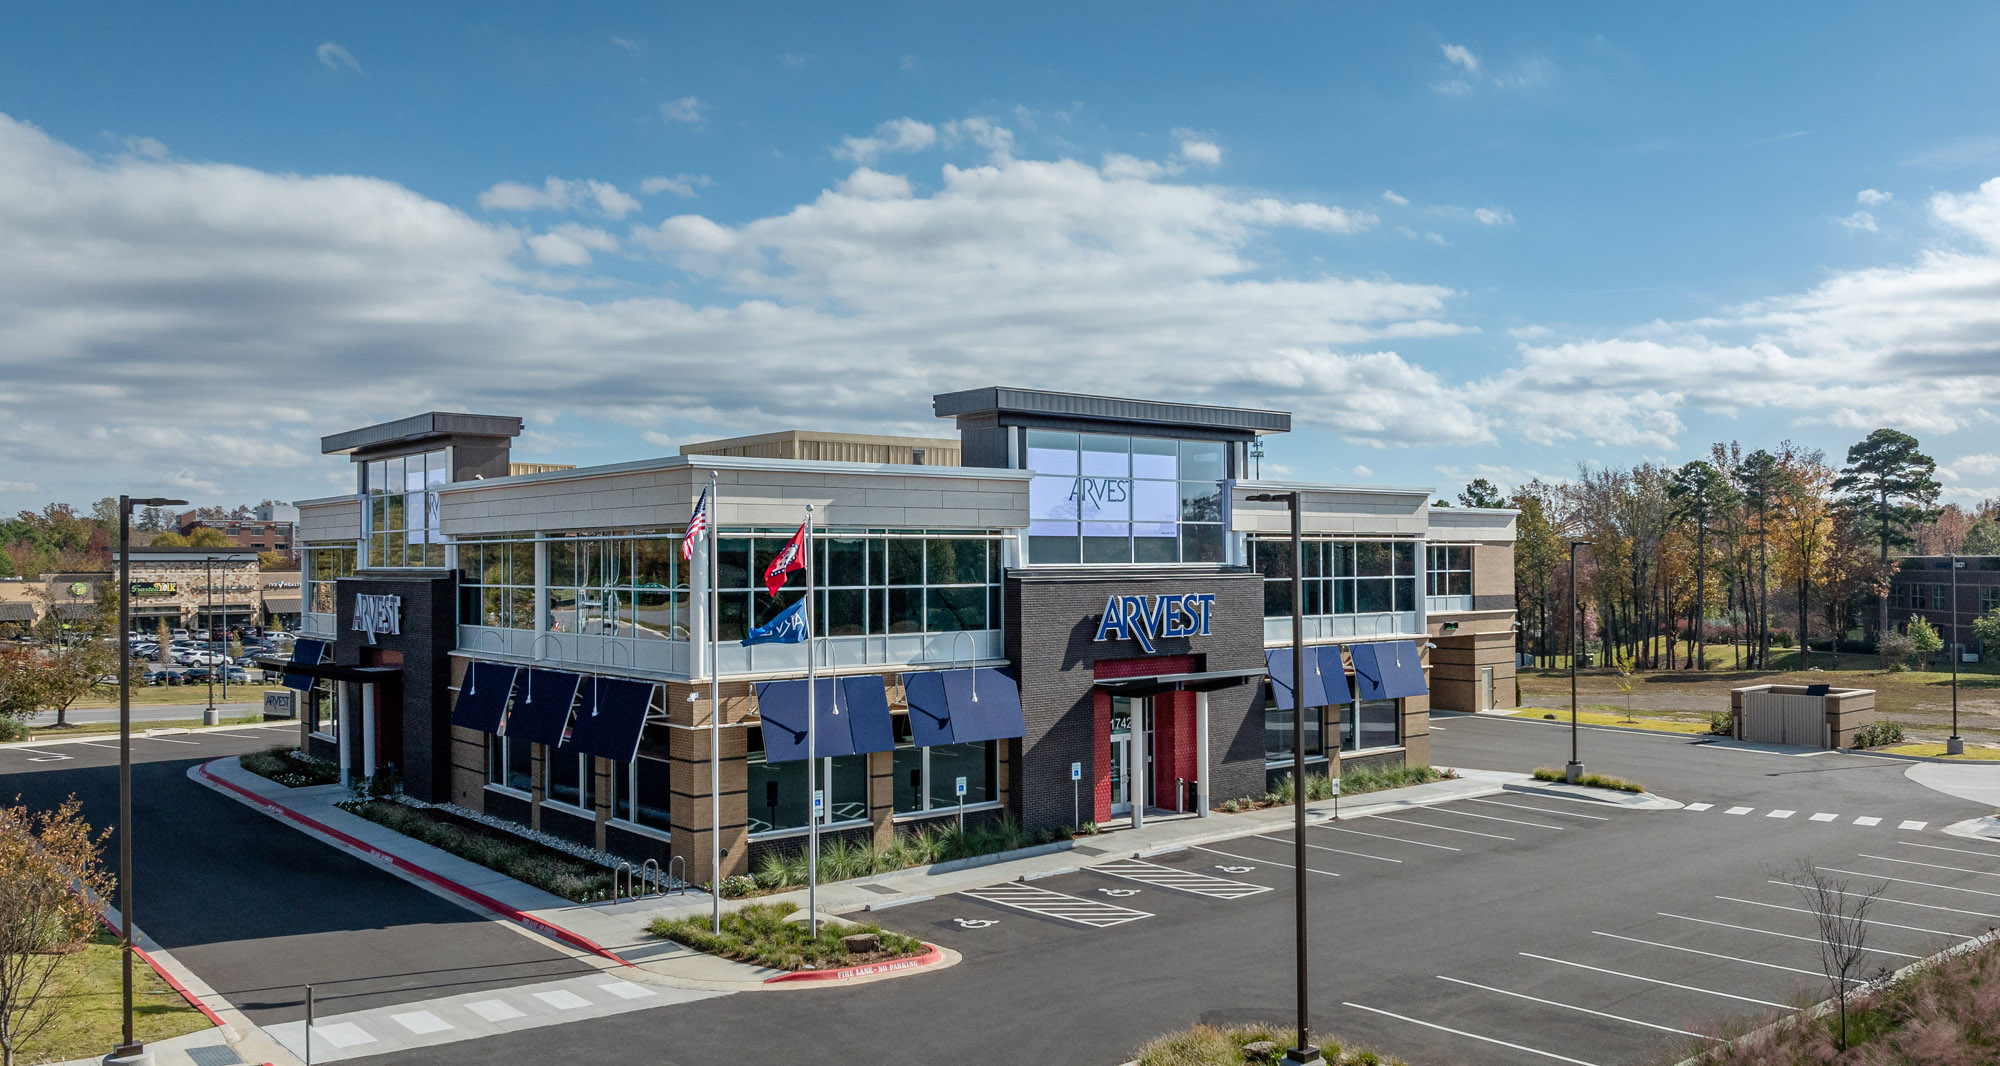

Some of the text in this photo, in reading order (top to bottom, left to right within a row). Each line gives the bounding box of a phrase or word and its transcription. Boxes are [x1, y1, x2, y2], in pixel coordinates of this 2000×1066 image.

[1068, 477, 1135, 510] ARVES
[153, 582, 177, 592] Yolk
[351, 592, 401, 645] ARVEST
[1092, 592, 1216, 653] ARVEST
[265, 695, 289, 710] ARVEST
[1110, 717, 1131, 731] 1742
[837, 969, 854, 979] FIRE
[878, 964, 887, 972] NO
[889, 960, 918, 971] PARKING
